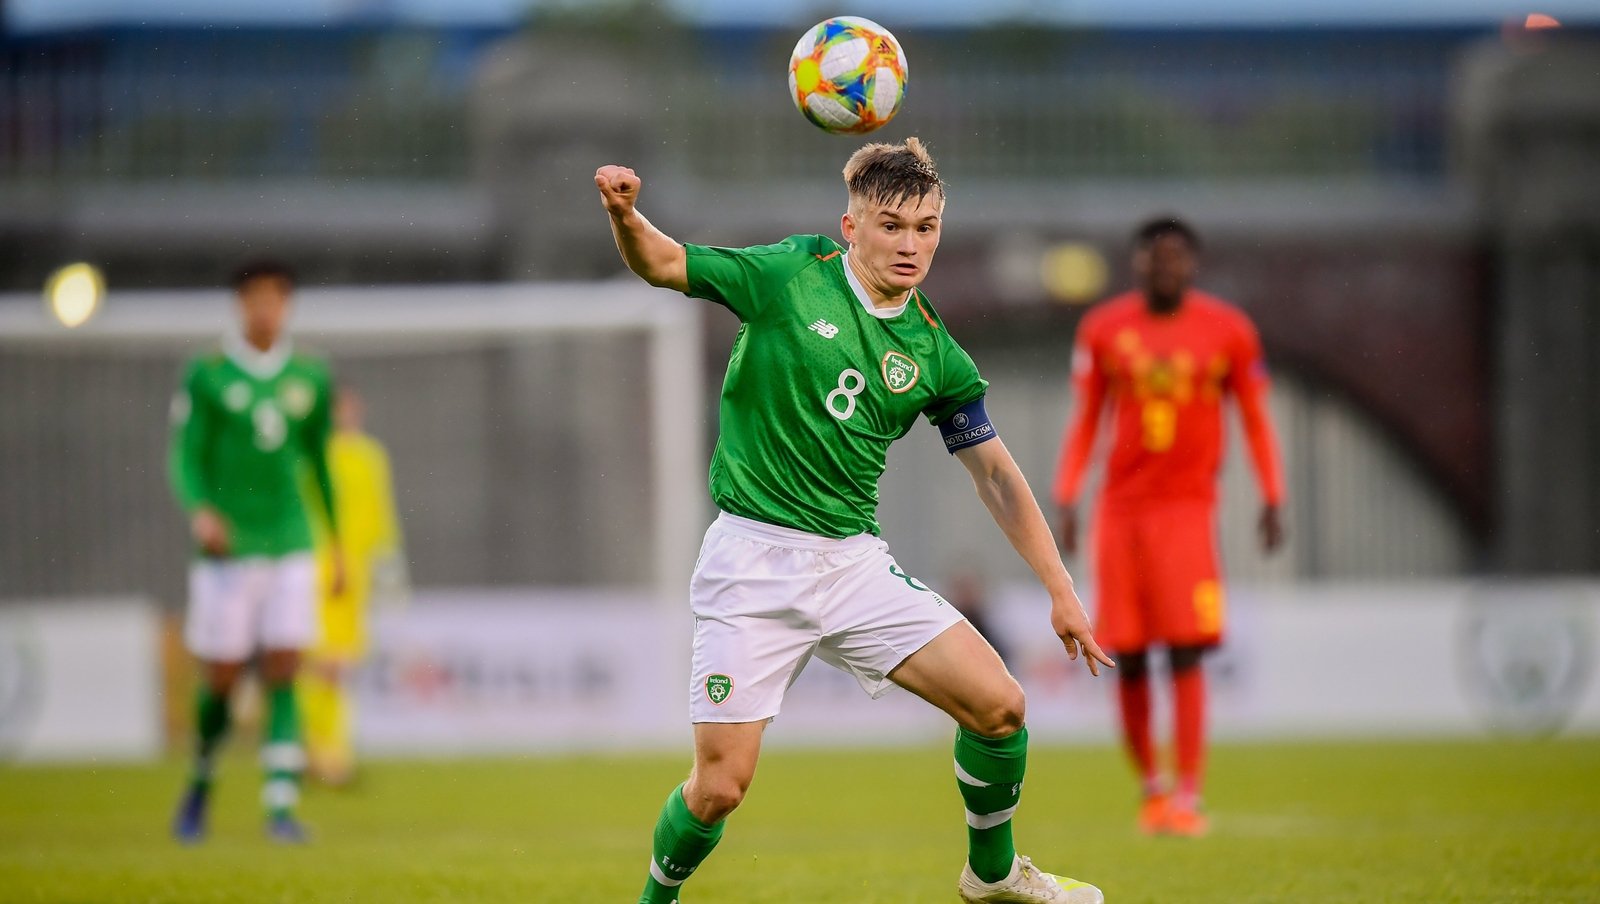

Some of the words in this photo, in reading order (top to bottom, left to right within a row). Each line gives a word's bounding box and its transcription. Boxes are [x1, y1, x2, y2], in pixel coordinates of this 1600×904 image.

[891, 355, 913, 371] Ireland
[826, 368, 866, 420] 8
[945, 437, 956, 446] NO
[955, 434, 964, 442] TO
[964, 425, 992, 440] RACISM
[709, 676, 728, 684] Ireland
